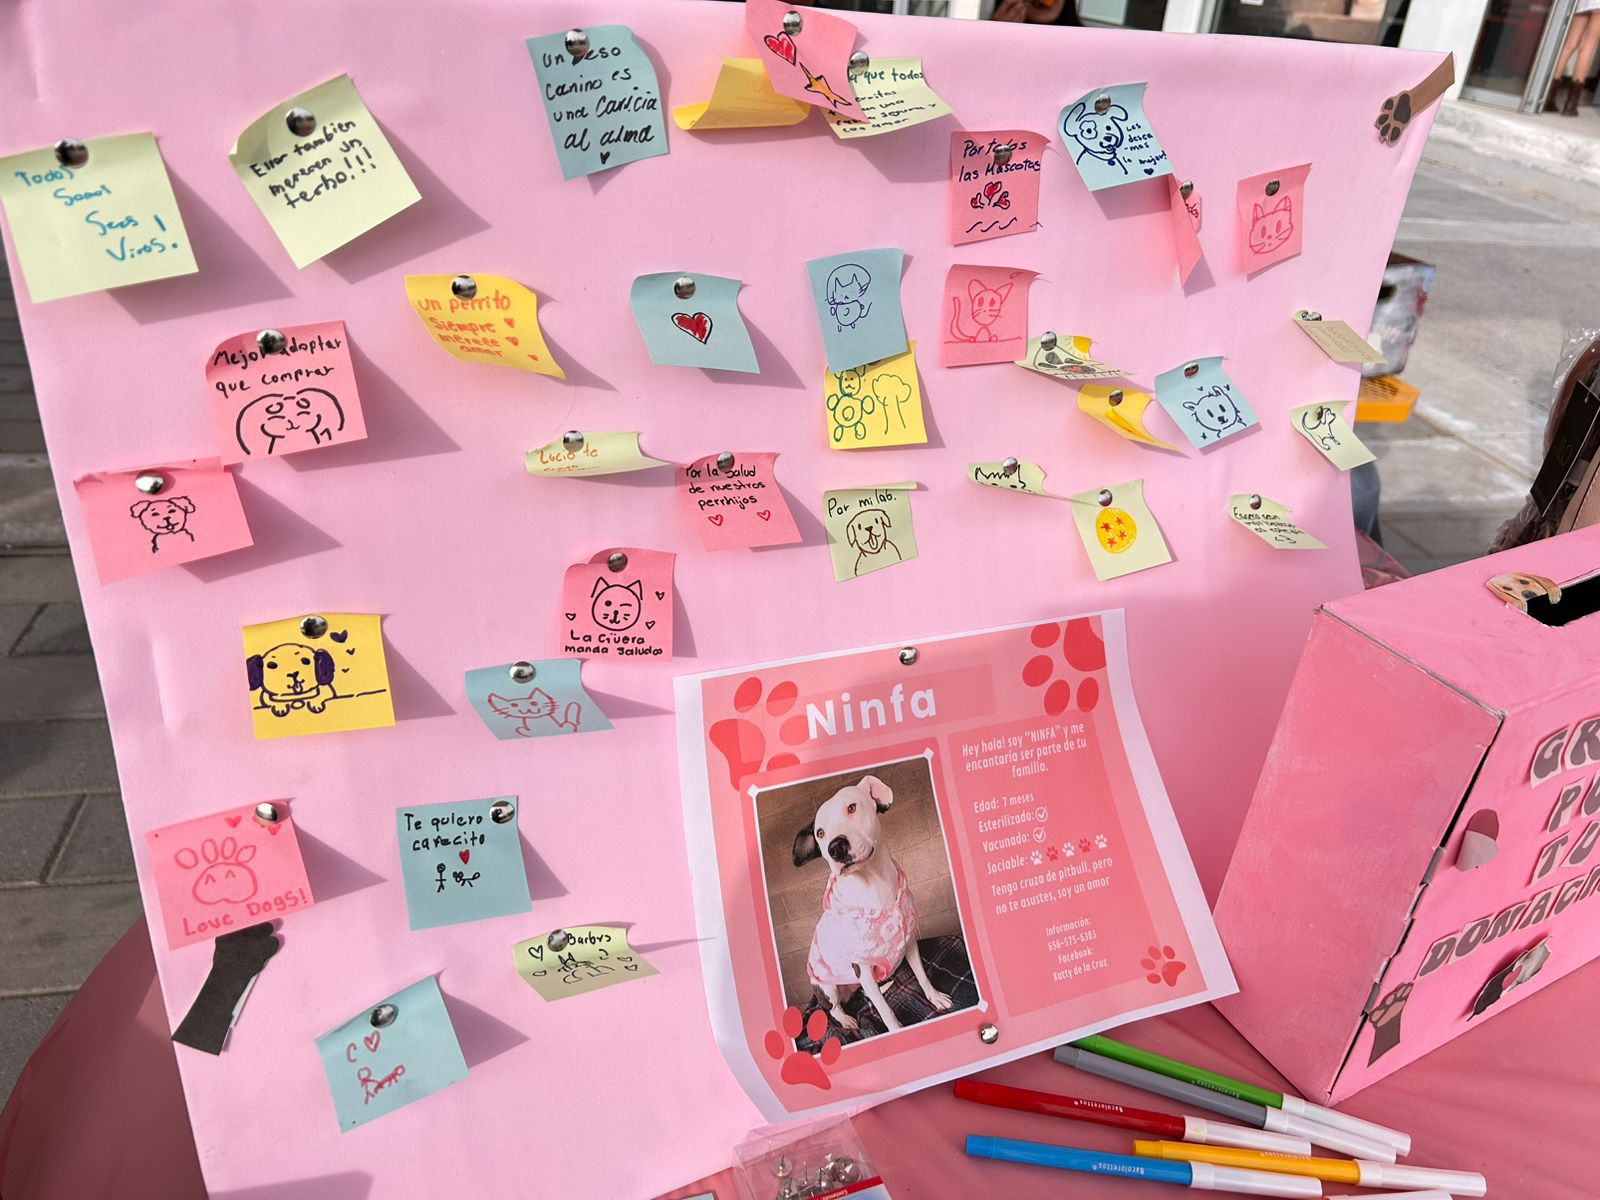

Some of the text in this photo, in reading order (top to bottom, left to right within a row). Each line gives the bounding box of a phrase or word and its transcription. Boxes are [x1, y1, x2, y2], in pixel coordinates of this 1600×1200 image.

[612, 68, 632, 80] es
[864, 70, 885, 84] que
[553, 105, 589, 122] una
[564, 124, 655, 152] al alma
[963, 139, 984, 159] Por
[14, 163, 75, 187] Todos
[958, 165, 979, 182] las
[449, 289, 512, 314] perrito
[215, 366, 335, 400] que comprar
[583, 442, 599, 458] te
[706, 463, 720, 477] la
[688, 480, 766, 494] de nuestros
[827, 498, 850, 518] Por
[858, 497, 874, 508] mi
[570, 629, 592, 642] La
[564, 645, 609, 654] manda
[805, 682, 937, 741] Ninfa
[962, 744, 980, 758] Hey
[981, 736, 1006, 753] hola!
[1007, 735, 1023, 749] soy
[1062, 727, 1070, 739] y
[1070, 723, 1084, 735] me
[1020, 748, 1034, 760] ser
[1036, 743, 1062, 760] parte
[1063, 738, 1076, 752] de
[1076, 737, 1088, 750] tu
[973, 792, 1035, 814] Edad: 7 meses
[404, 812, 483, 832] Te quiero
[978, 811, 1035, 833] Esterilizado:
[982, 832, 1030, 854] Vacunado:
[986, 854, 1028, 875] Sociable:
[990, 881, 1019, 898] Tengo
[1020, 874, 1045, 890] cruza
[1046, 870, 1057, 882] de
[1092, 856, 1114, 873] pero
[995, 876, 1111, 916] no te asustes, soy un amor
[182, 914, 235, 936] Love
[1073, 964, 1082, 976] de
[1092, 958, 1108, 970] Cruz
